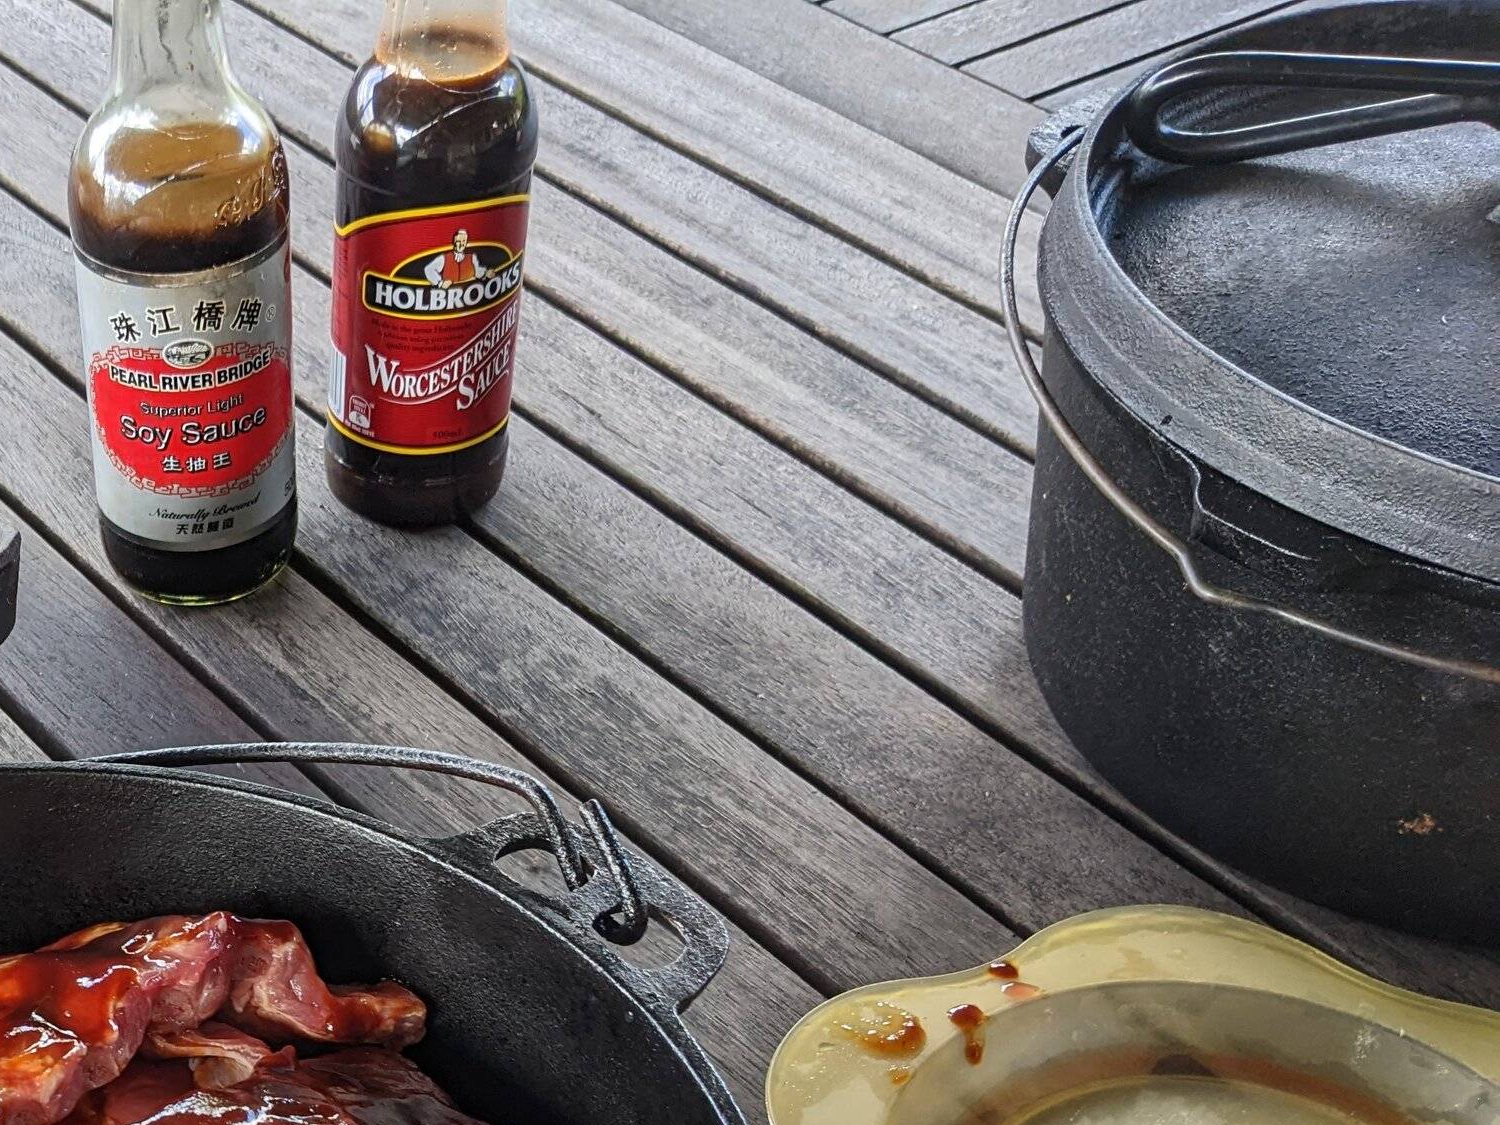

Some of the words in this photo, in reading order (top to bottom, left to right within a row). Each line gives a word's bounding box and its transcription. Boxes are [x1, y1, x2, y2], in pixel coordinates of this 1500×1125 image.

[374, 260, 520, 312] HOLBROOKS
[109, 298, 262, 342] 珠江橋牌
[110, 365, 159, 390] PEARL
[162, 373, 213, 391] RIVER
[217, 351, 271, 385] BRIDGE
[364, 299, 517, 399] WORCESTERSHIRE
[456, 339, 512, 411] SAUCE
[140, 401, 204, 419] Superior
[207, 393, 244, 414] Light
[120, 415, 173, 451] Soy
[181, 407, 266, 444] Sauce
[162, 451, 231, 473] 生抽王
[149, 507, 210, 526] Naturally
